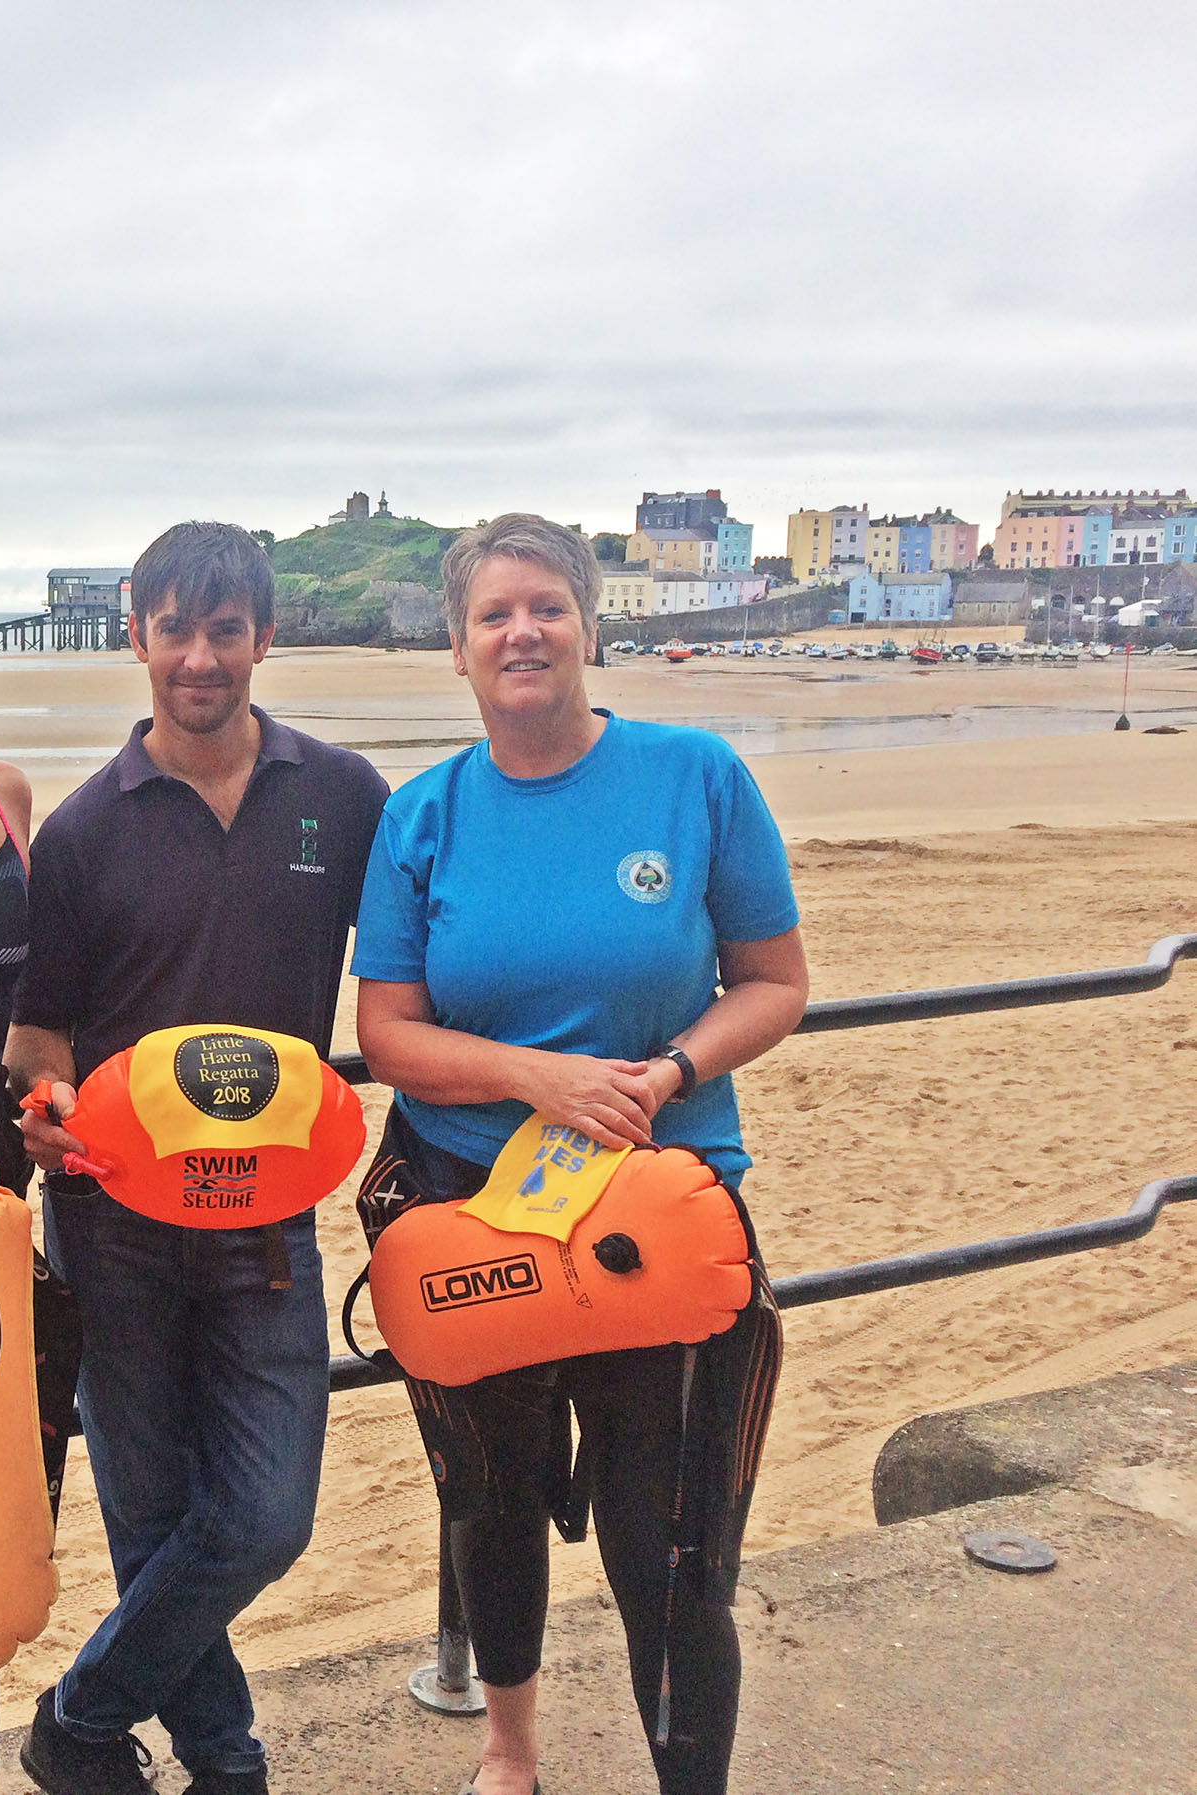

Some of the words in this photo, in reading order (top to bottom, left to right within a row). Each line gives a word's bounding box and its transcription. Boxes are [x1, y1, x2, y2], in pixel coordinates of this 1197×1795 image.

[201, 1037, 243, 1051] Little
[200, 1051, 252, 1066] Haven
[198, 1066, 259, 1084] Regatta
[212, 1085, 252, 1105] 2018
[540, 1123, 609, 1157] TENBY
[184, 1155, 257, 1175] SWIM
[182, 1192, 255, 1208] SECURE
[426, 1262, 534, 1305] LOMO
